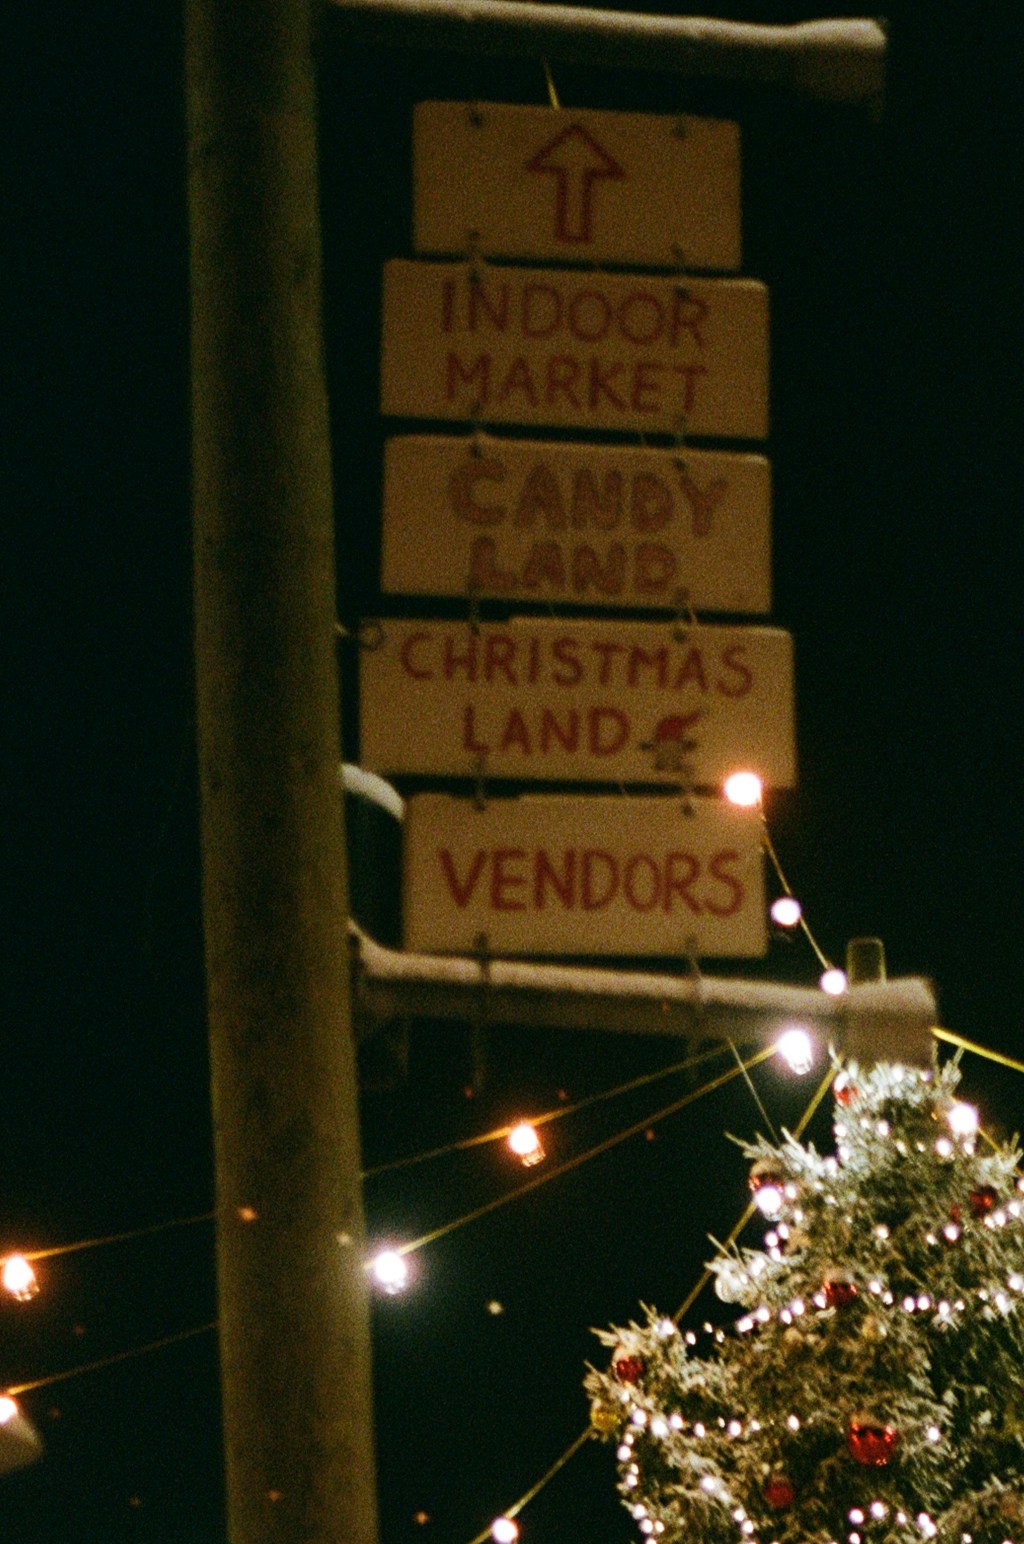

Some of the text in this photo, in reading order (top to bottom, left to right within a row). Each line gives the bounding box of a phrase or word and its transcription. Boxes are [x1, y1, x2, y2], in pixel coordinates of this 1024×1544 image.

[441, 277, 709, 347] INDOOR
[445, 352, 709, 413] MARKET
[448, 458, 729, 537] CANDY
[469, 536, 679, 595] LAND
[401, 632, 754, 698] CHRISTMAS
[462, 706, 632, 757] LAND
[438, 849, 746, 917] VENDORS
